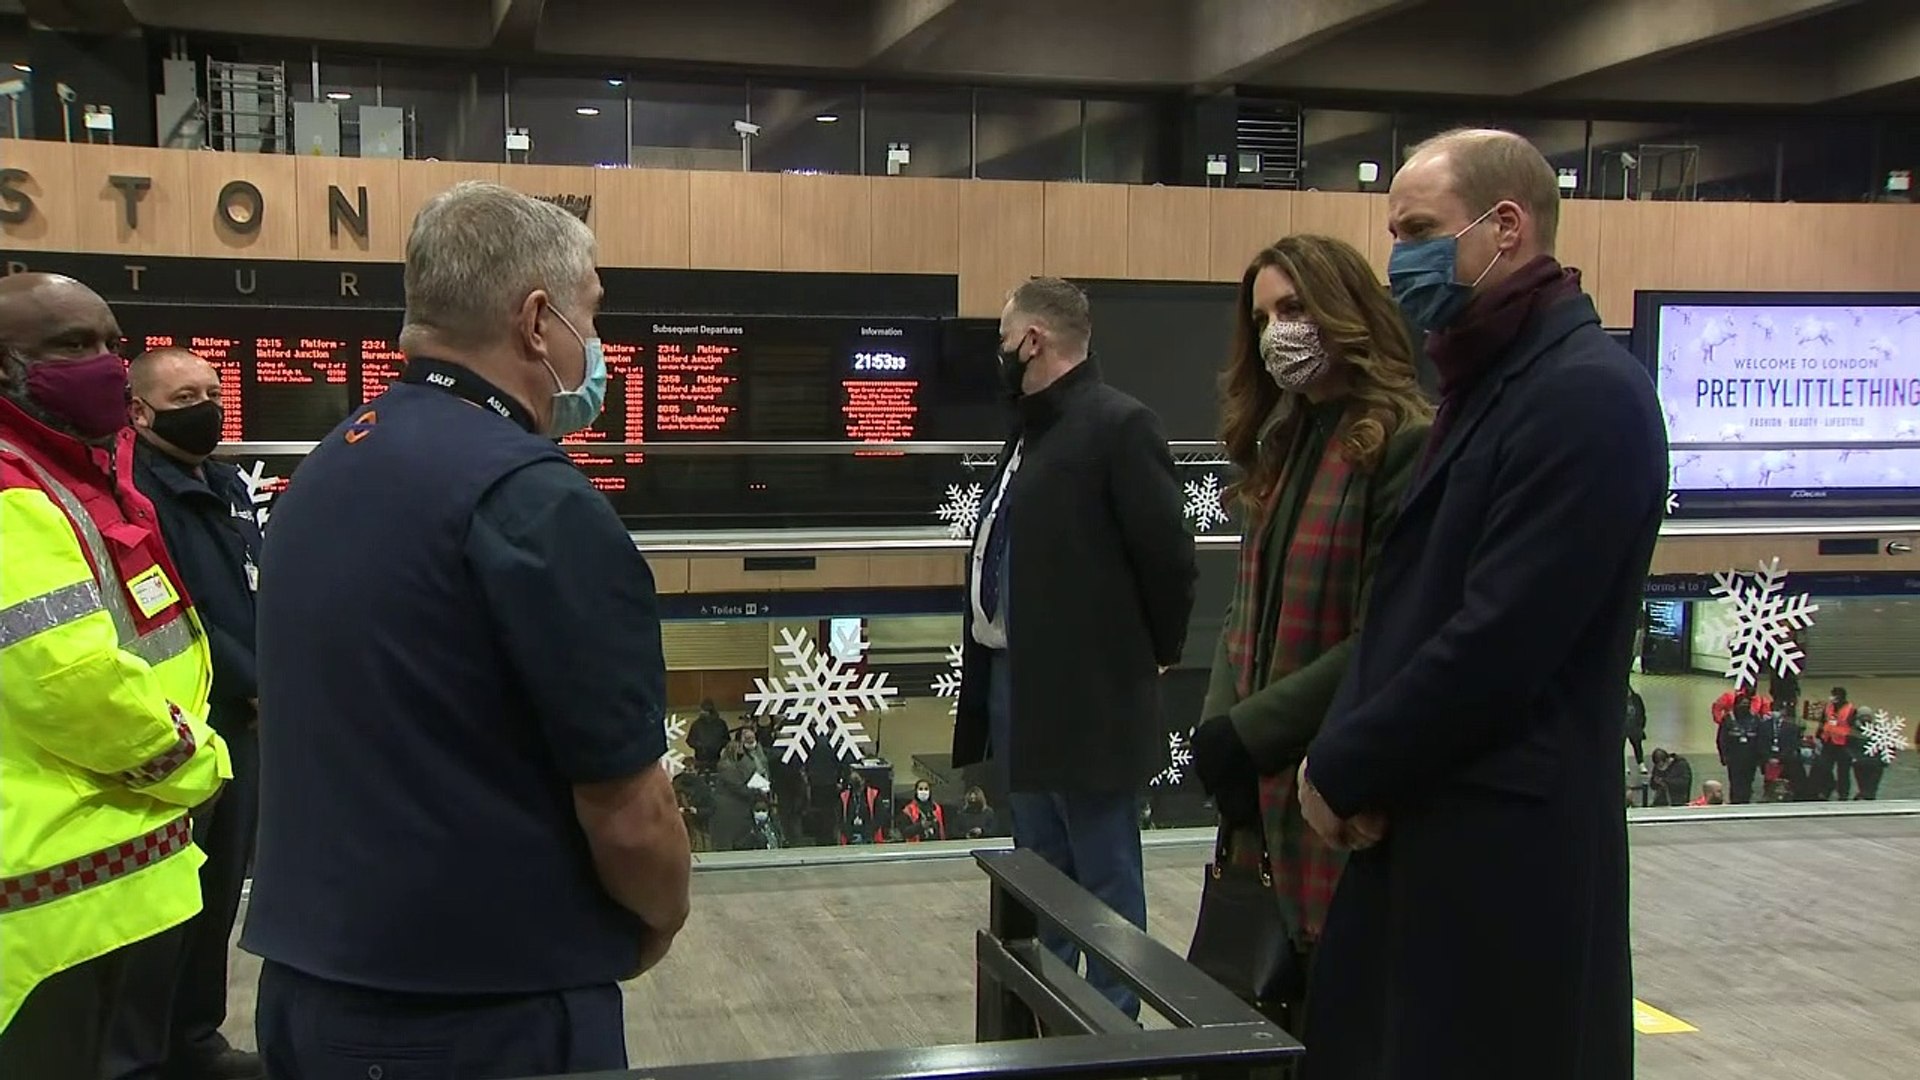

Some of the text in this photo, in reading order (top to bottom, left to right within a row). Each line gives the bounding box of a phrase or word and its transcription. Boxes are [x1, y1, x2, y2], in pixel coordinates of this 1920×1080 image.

[652, 324, 744, 335] Subsequent Departures
[861, 327, 903, 336] Information
[191, 337, 231, 347] Platform
[256, 338, 338, 349] 23:15 Platform
[361, 340, 386, 349] 23:24
[657, 344, 731, 354] 23:44 Platform
[256, 350, 330, 359] Watford Junction
[657, 354, 723, 363] Watford Junction
[1734, 358, 1879, 369] WELCOME TO LONDON
[426, 372, 456, 387] ASLEF
[696, 375, 730, 384] Platform
[657, 384, 723, 393] Watford Junction
[1696, 378, 1920, 408] PRETTYLITTLETHING
[487, 396, 511, 418] ASLEF
[696, 405, 729, 414] Platform
[1749, 417, 1865, 427] FASHION BEAUTY LIFESTYLE
[1687, 582, 1699, 591] to
[711, 605, 742, 616] Toilets
